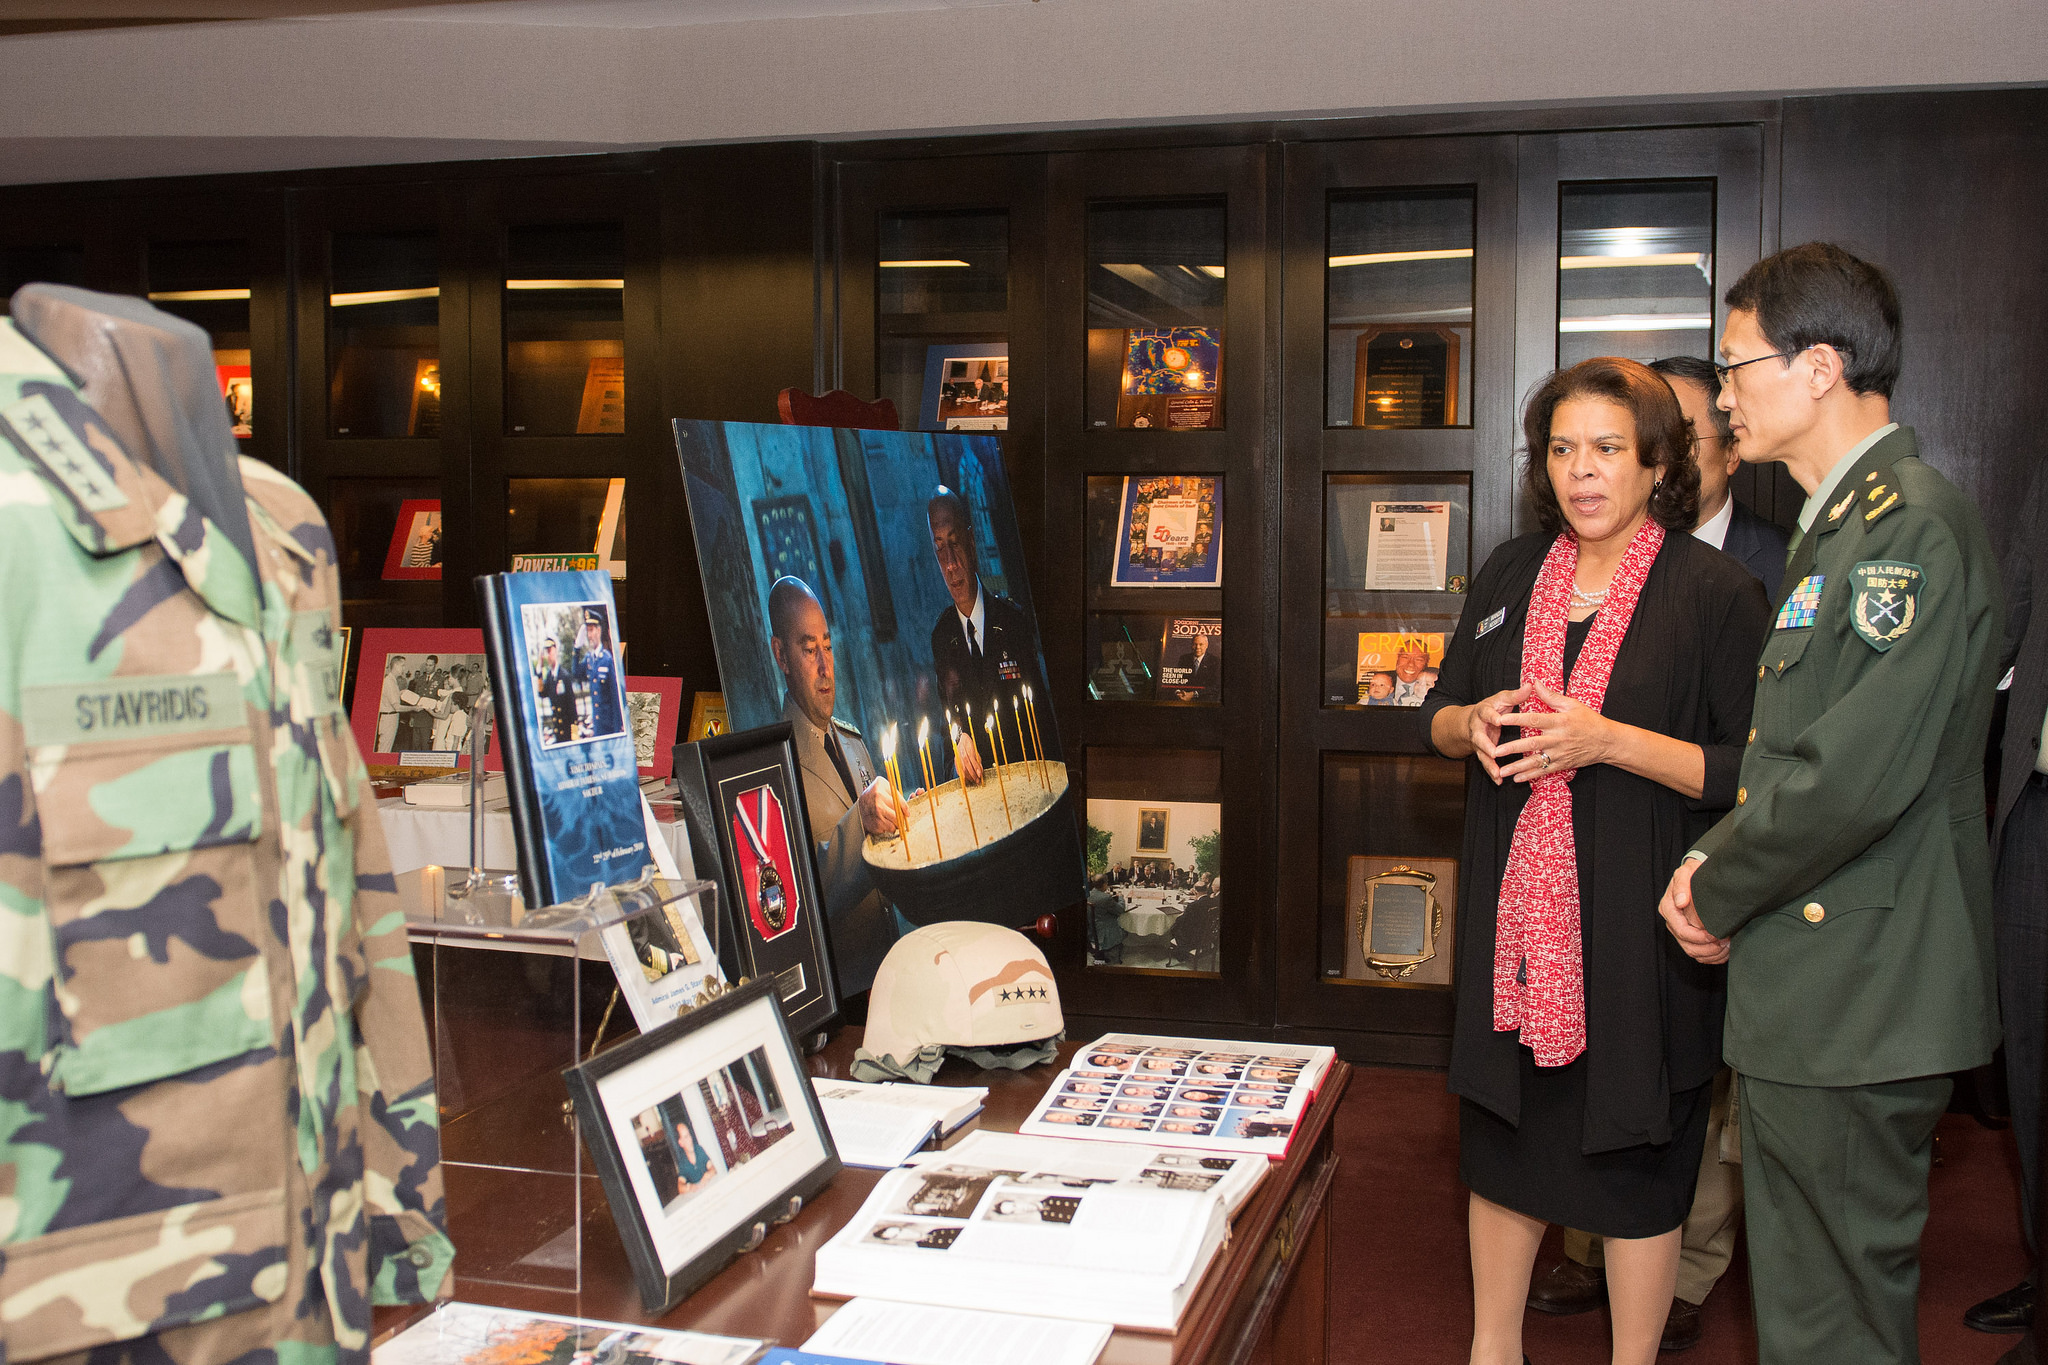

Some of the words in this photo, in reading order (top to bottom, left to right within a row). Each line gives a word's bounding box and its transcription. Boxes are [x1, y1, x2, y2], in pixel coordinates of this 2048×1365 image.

[512, 556, 569, 573] POWELL
[1858, 566, 1919, 579] 中国人民解放军
[1867, 577, 1908, 589] 国防大学
[1173, 625, 1221, 635] 30DAYS
[1360, 633, 1443, 653] GRAND
[1360, 652, 1381, 666] 10
[76, 686, 209, 730] STAVRIDIS
